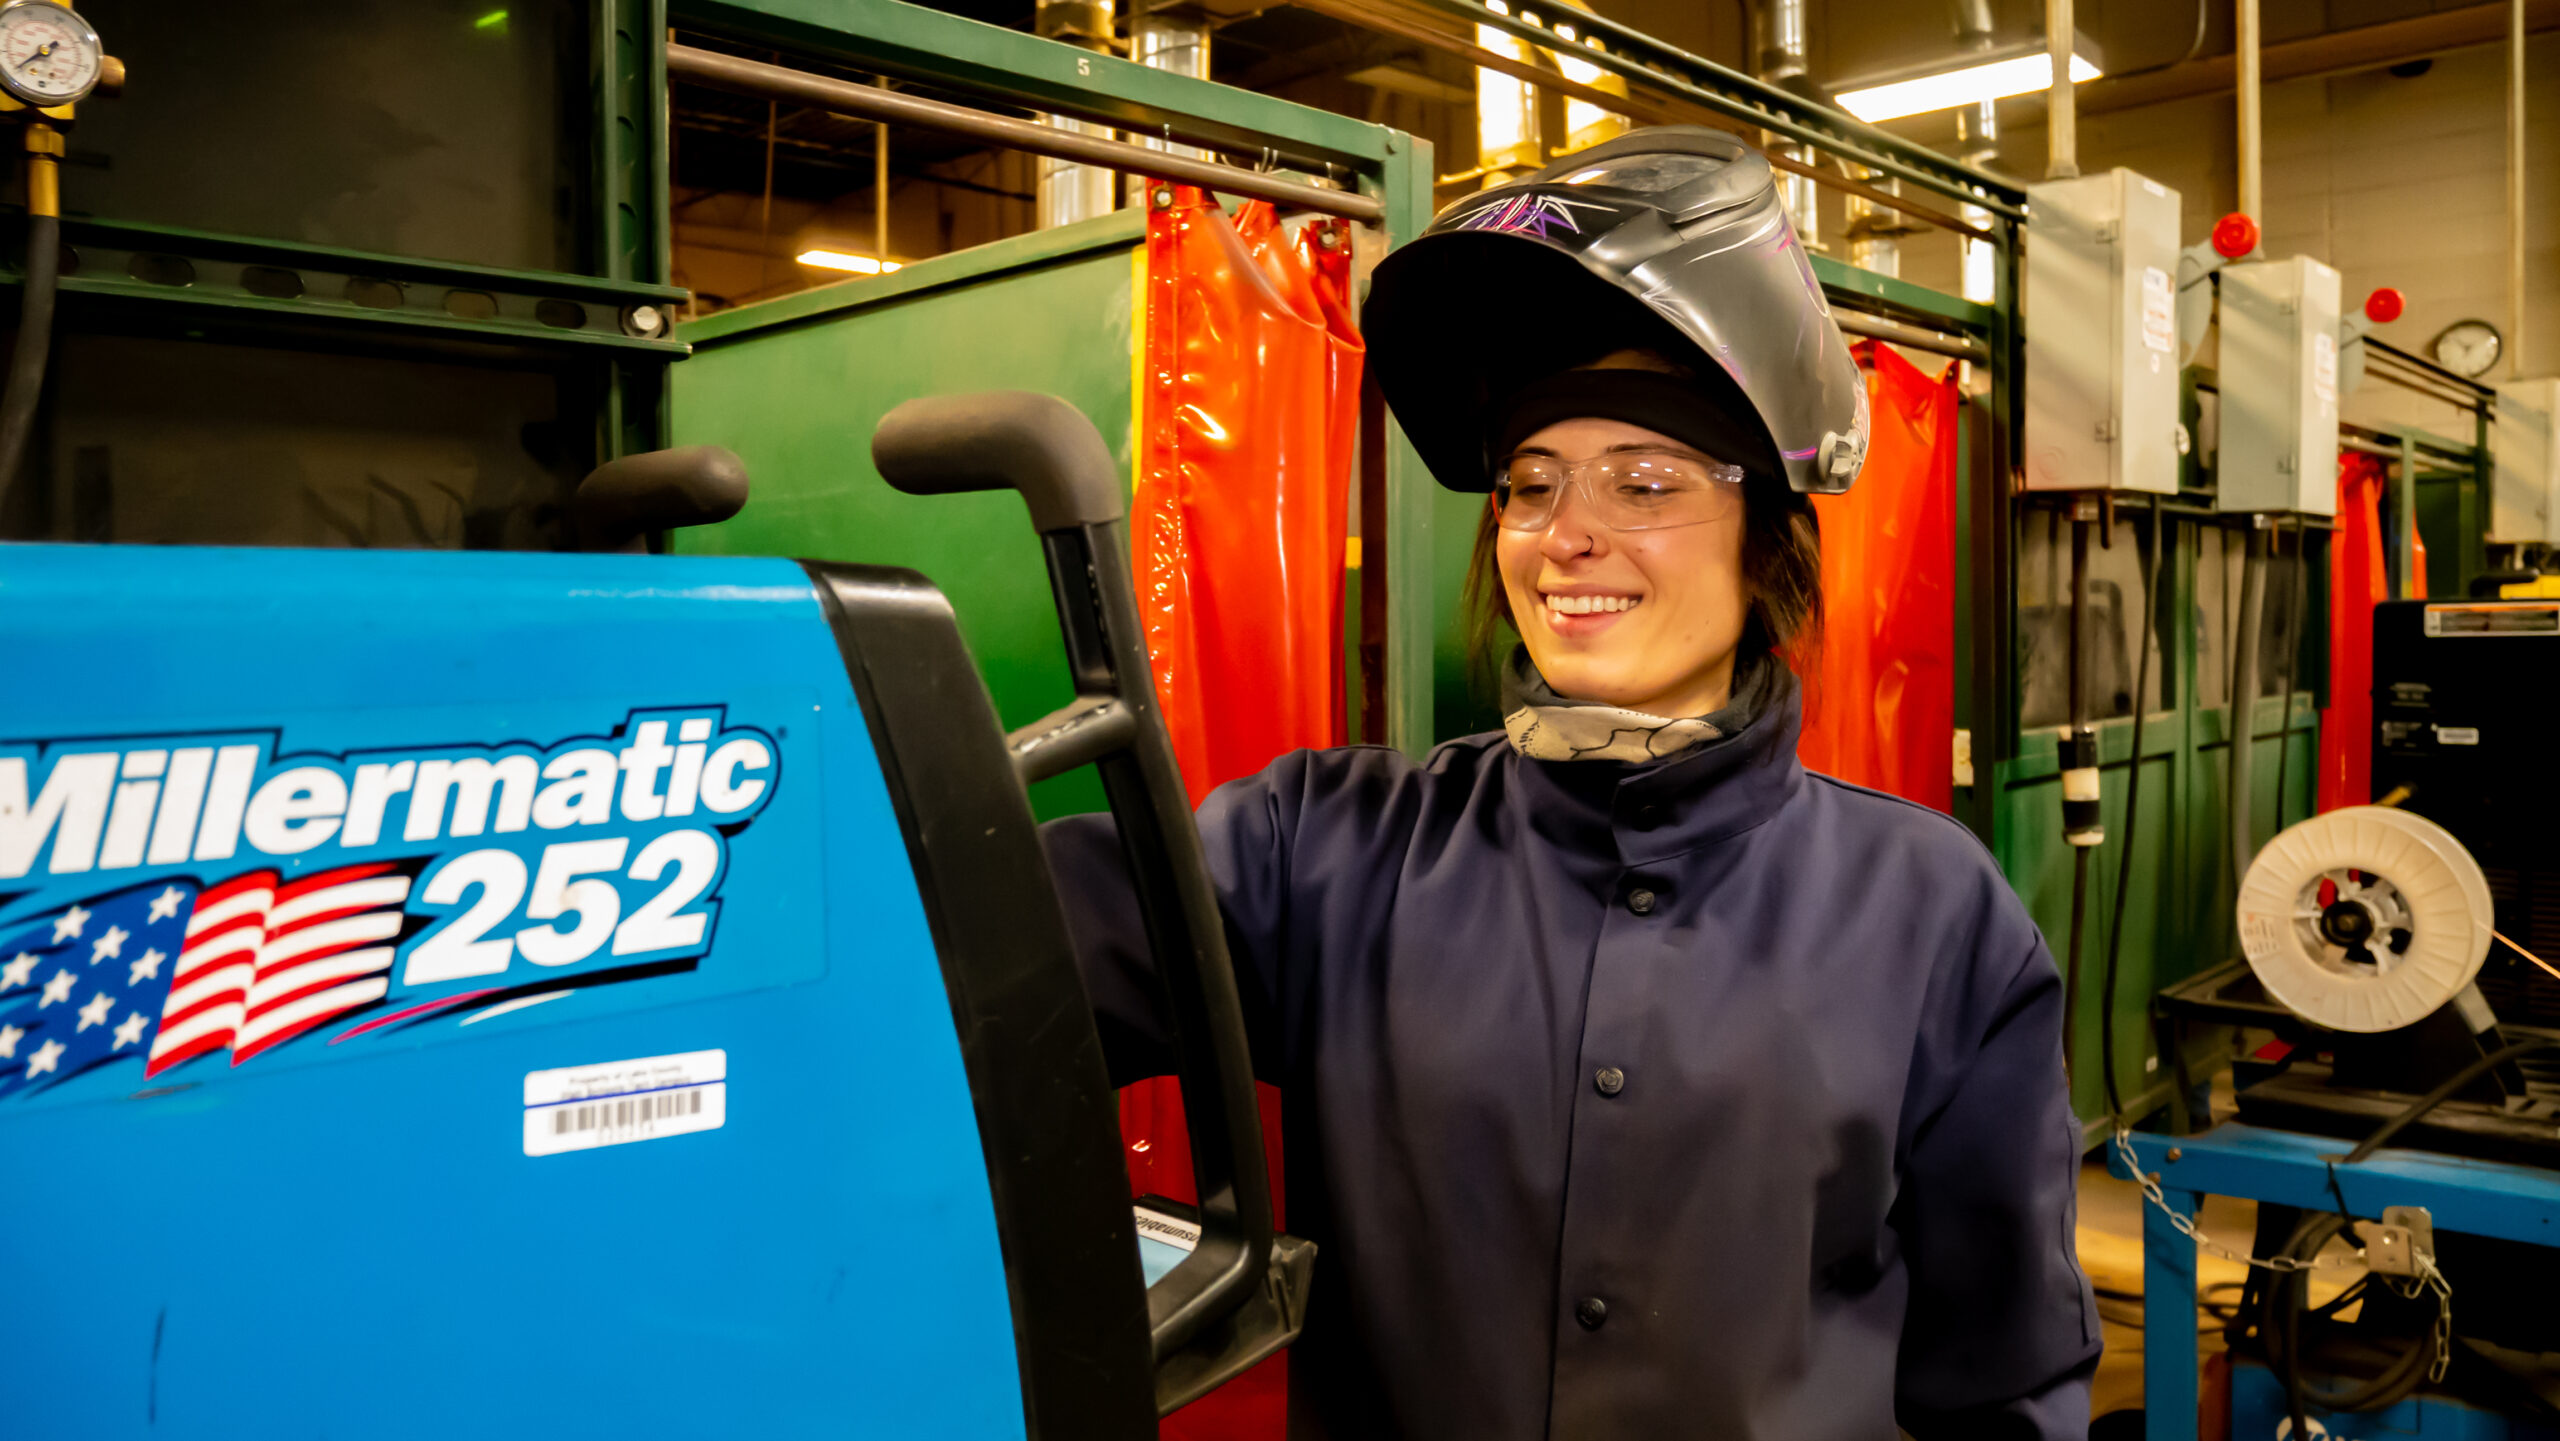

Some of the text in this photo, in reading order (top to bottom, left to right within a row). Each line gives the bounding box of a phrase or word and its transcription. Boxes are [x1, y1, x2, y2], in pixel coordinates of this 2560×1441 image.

[1078, 57, 1090, 76] 5
[0, 717, 771, 879] Millermatic
[404, 828, 722, 986] 252
